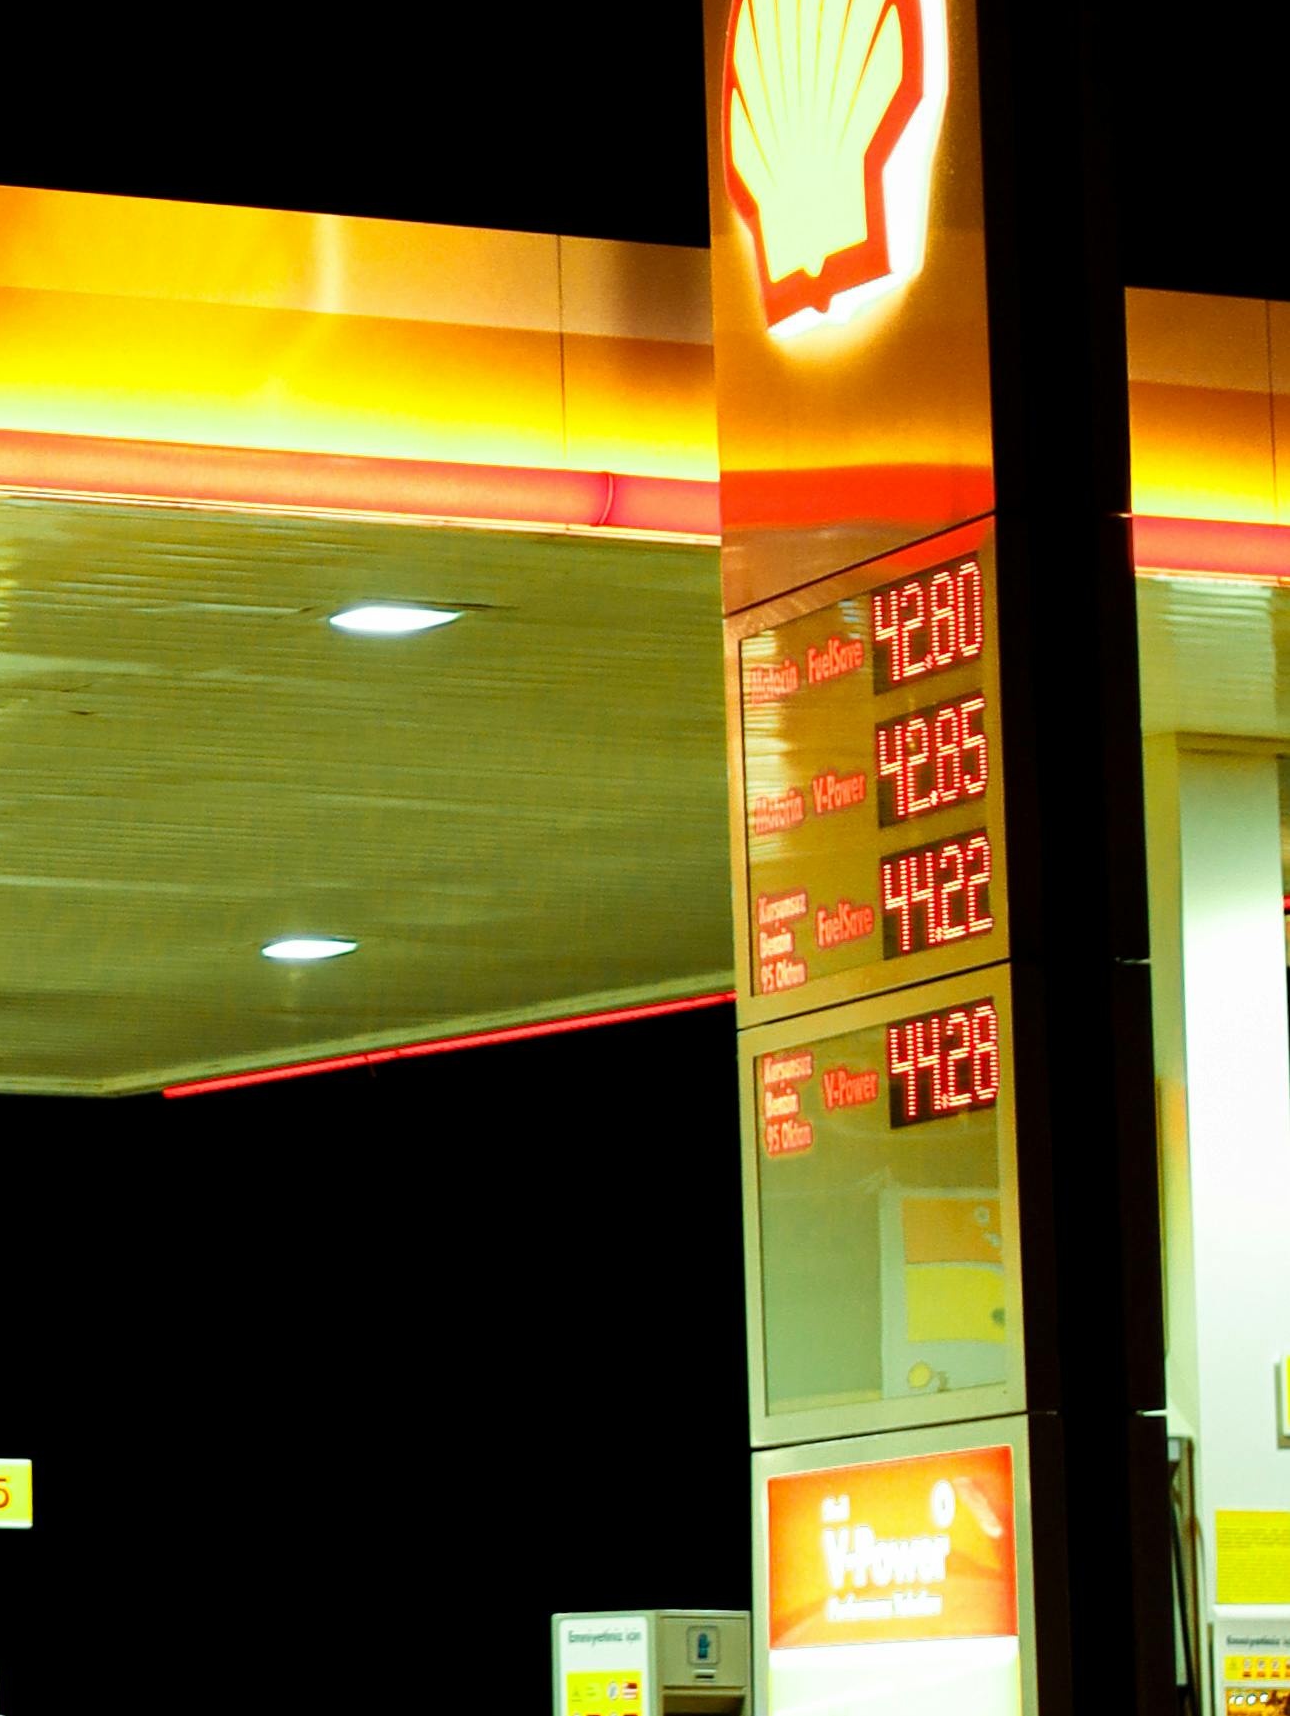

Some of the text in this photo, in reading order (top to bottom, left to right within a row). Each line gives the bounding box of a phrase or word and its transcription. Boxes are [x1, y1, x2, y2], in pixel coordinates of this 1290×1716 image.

[807, 637, 864, 684] FuelSave
[812, 772, 866, 813] V-Power
[818, 901, 874, 948] FuelSave
[824, 1067, 879, 1109] V-Power
[823, 1525, 950, 1589] V-Power
